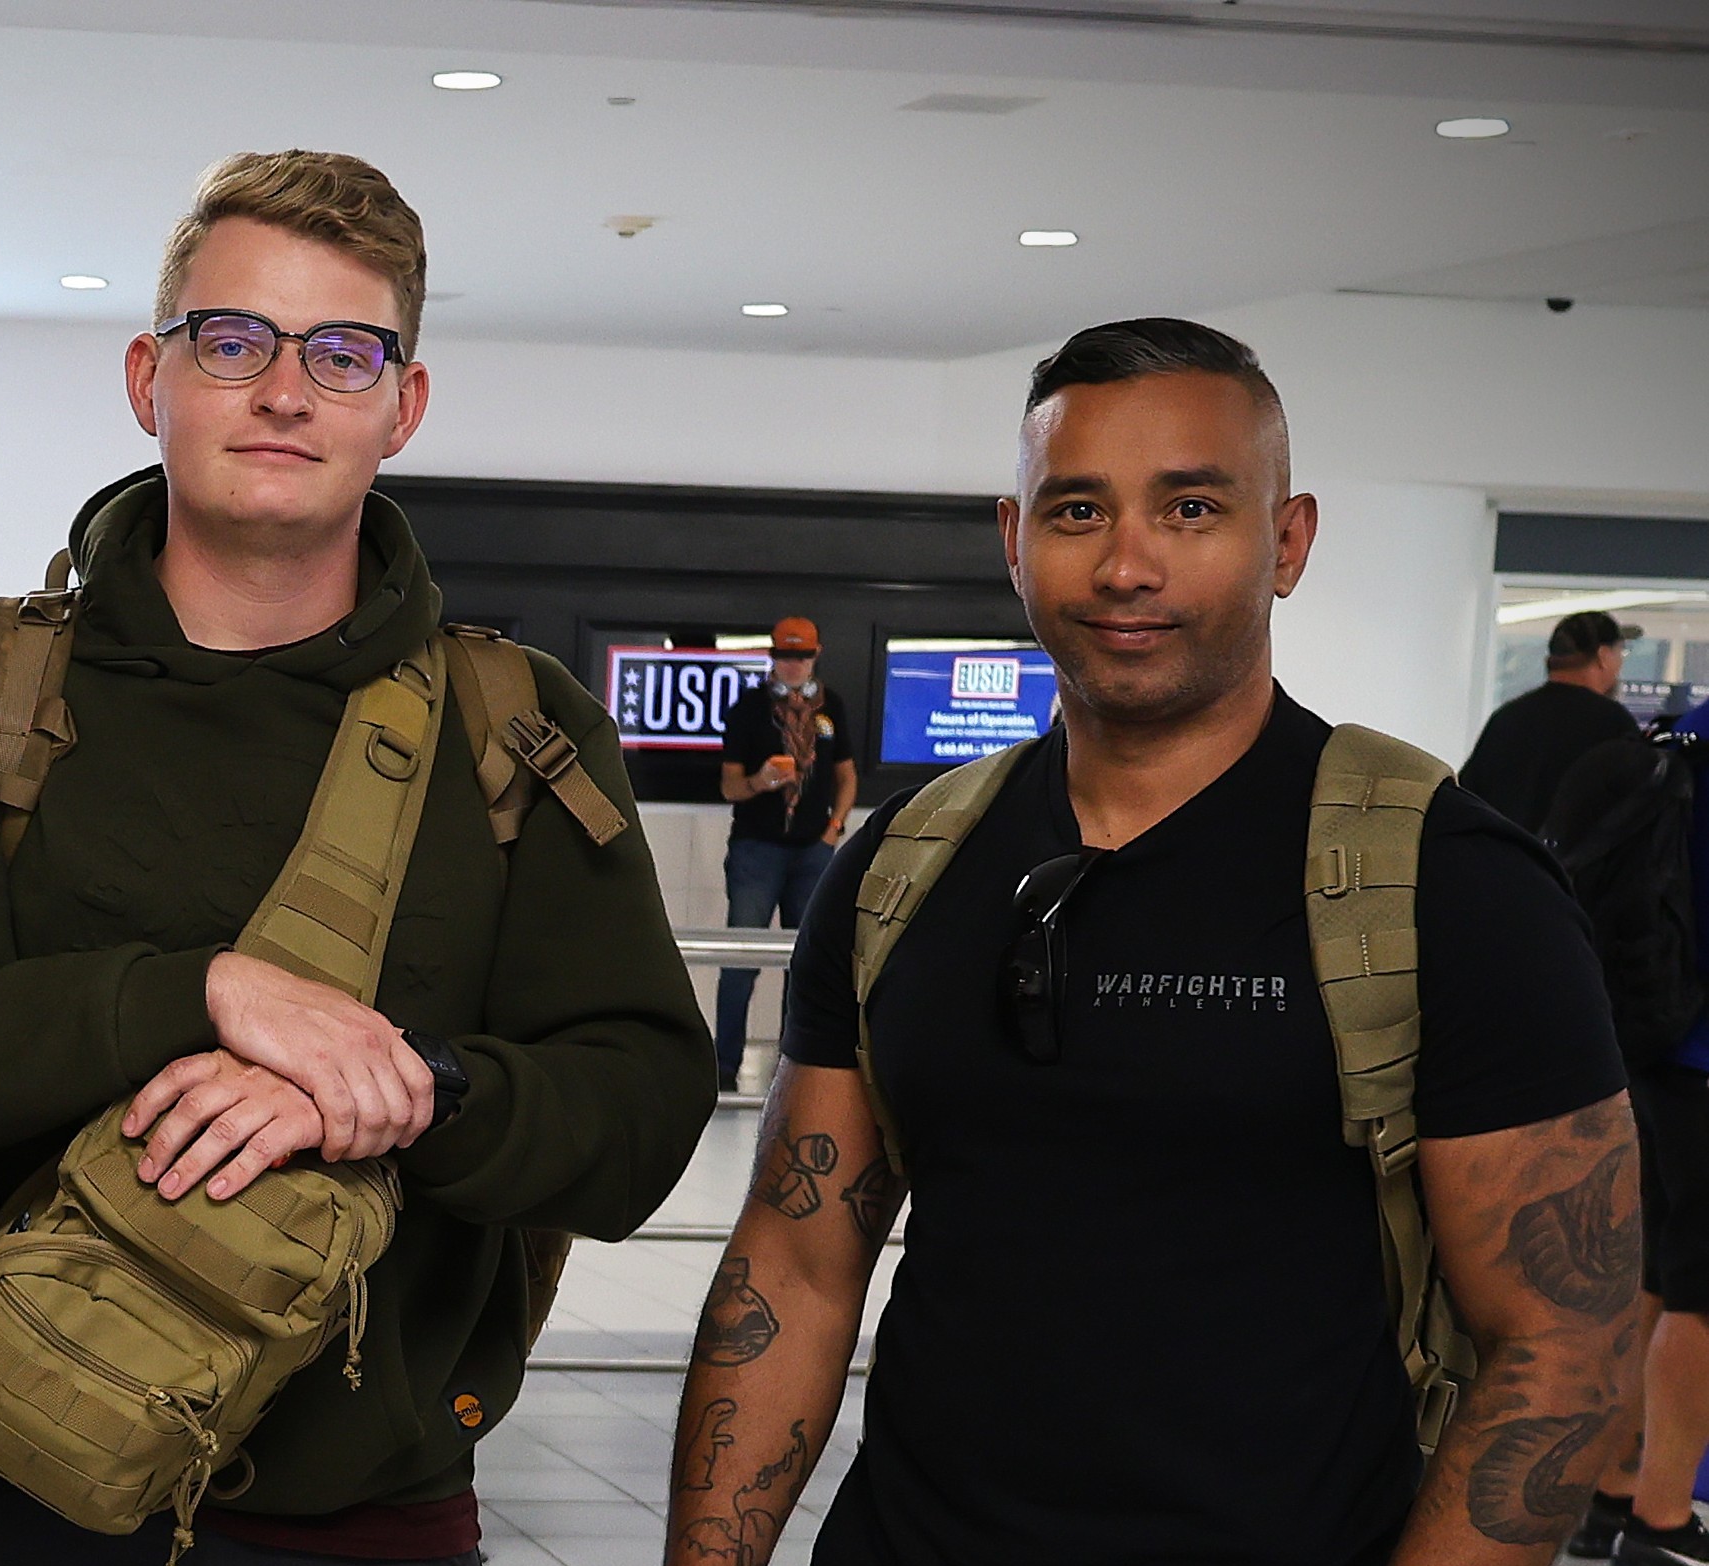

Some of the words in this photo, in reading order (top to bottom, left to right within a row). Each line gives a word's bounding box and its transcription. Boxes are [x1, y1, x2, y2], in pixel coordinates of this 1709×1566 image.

[968, 664, 1004, 692] USO
[1096, 973, 1287, 998] WARFIGHTER
[1093, 995, 1287, 1012] ATHLETIC
[456, 1402, 482, 1419] smile
